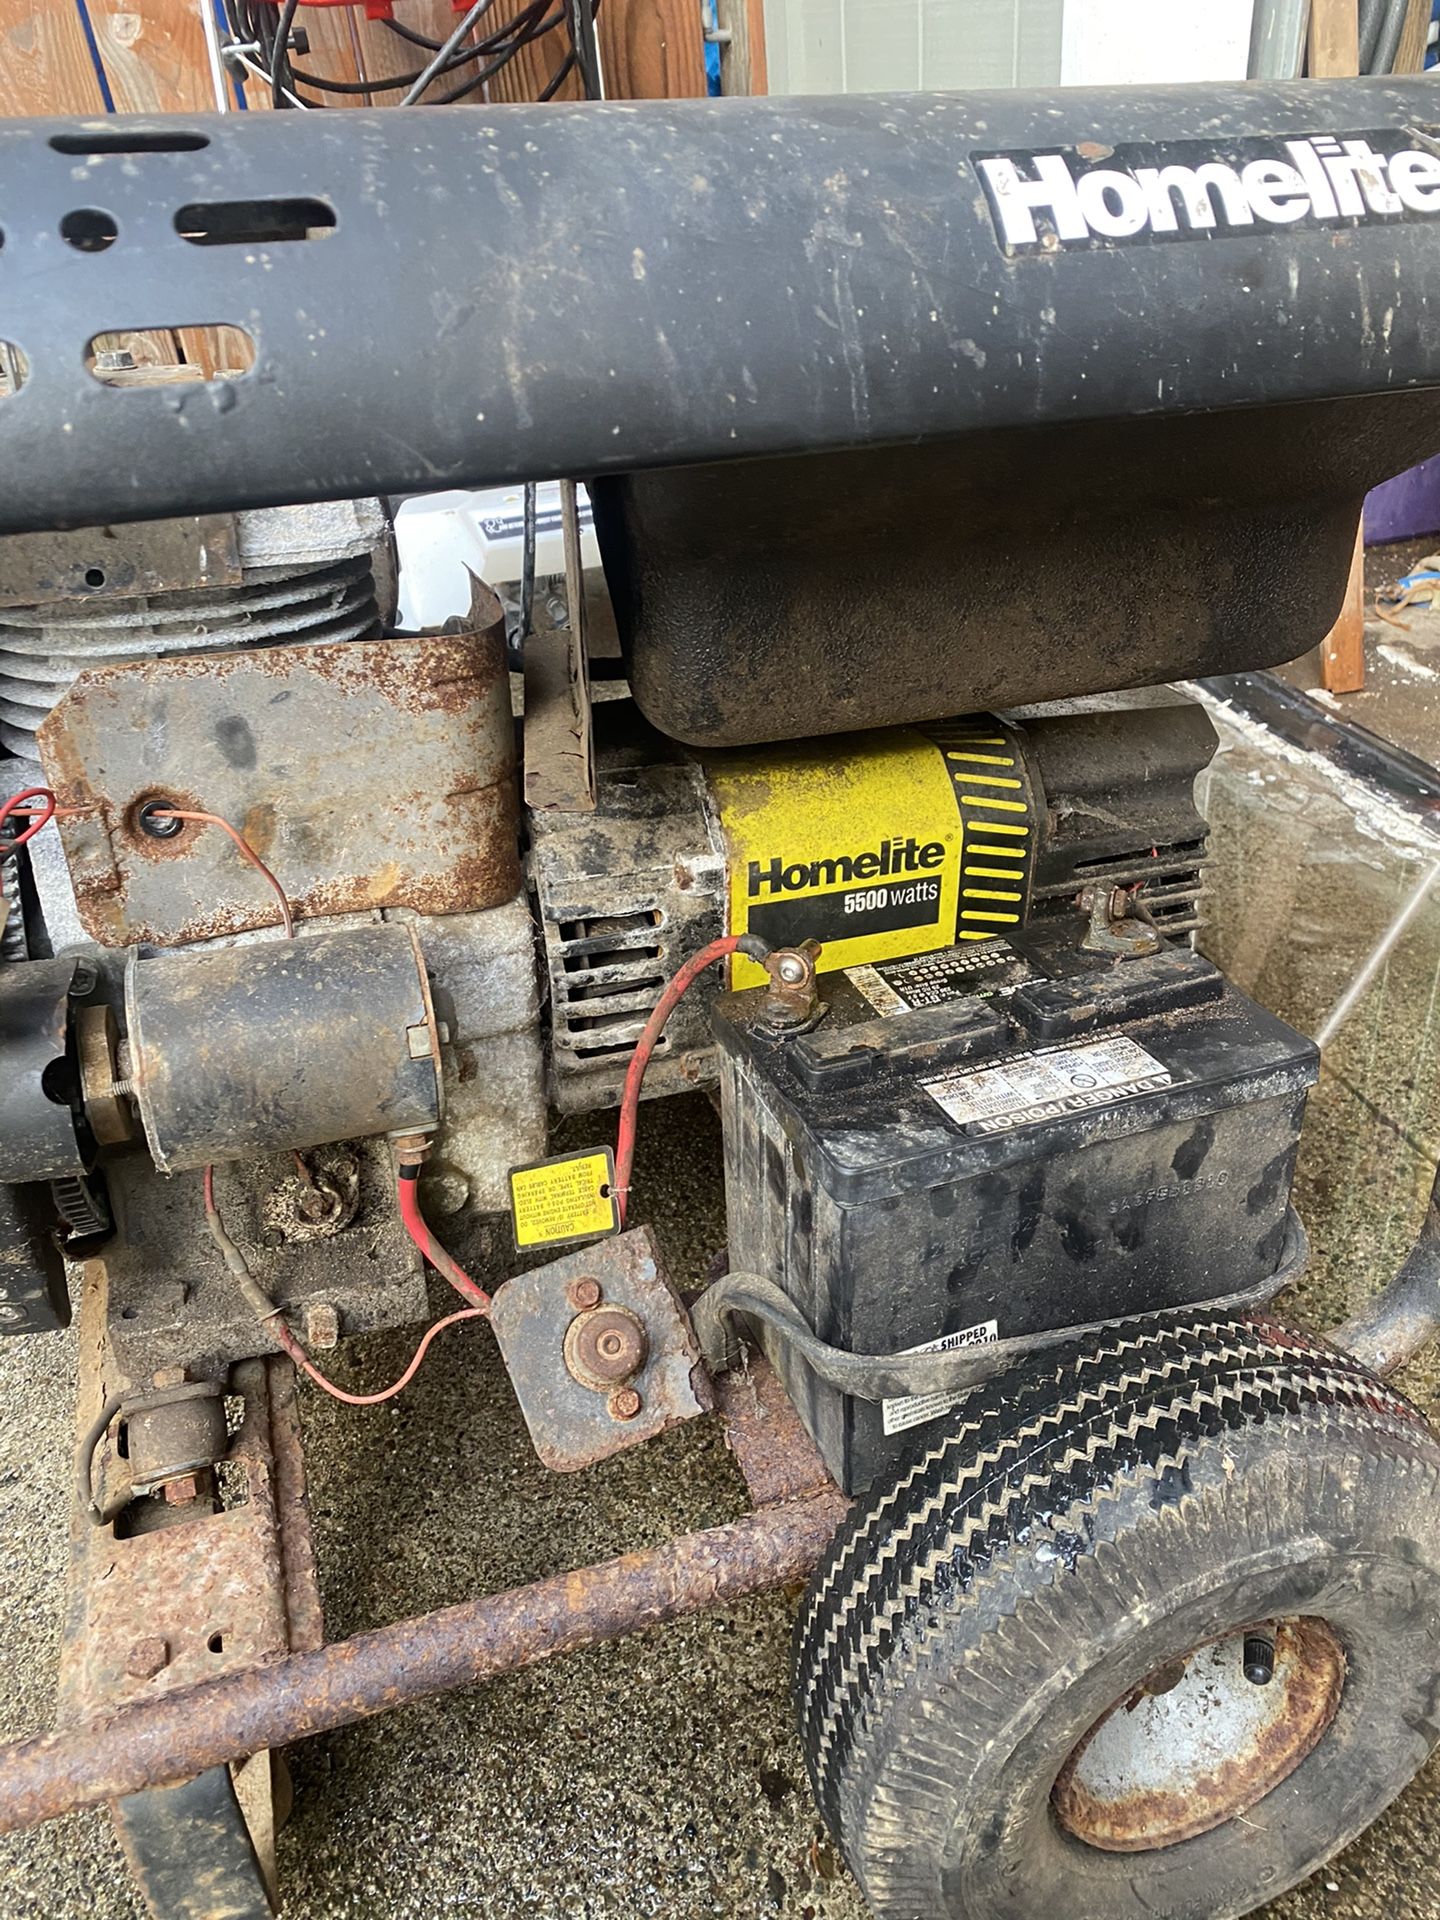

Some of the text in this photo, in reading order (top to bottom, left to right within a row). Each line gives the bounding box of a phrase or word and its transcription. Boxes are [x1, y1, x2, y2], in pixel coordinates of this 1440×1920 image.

[982, 136, 1440, 245] Homelite
[748, 836, 945, 897] Homelite
[844, 880, 939, 914] 5500 watts
[550, 1173, 575, 1184] BATTERY
[577, 1169, 592, 1178] FROM
[528, 1180, 547, 1189] CABLES
[578, 1184, 594, 1193] CABLE
[518, 1203, 543, 1213] BATTERY
[562, 1202, 584, 1211] OPERATE
[519, 1211, 540, 1220] WITHOUT
[544, 1222, 574, 1235] CAUTION
[941, 1326, 986, 1350] SHIPPED
